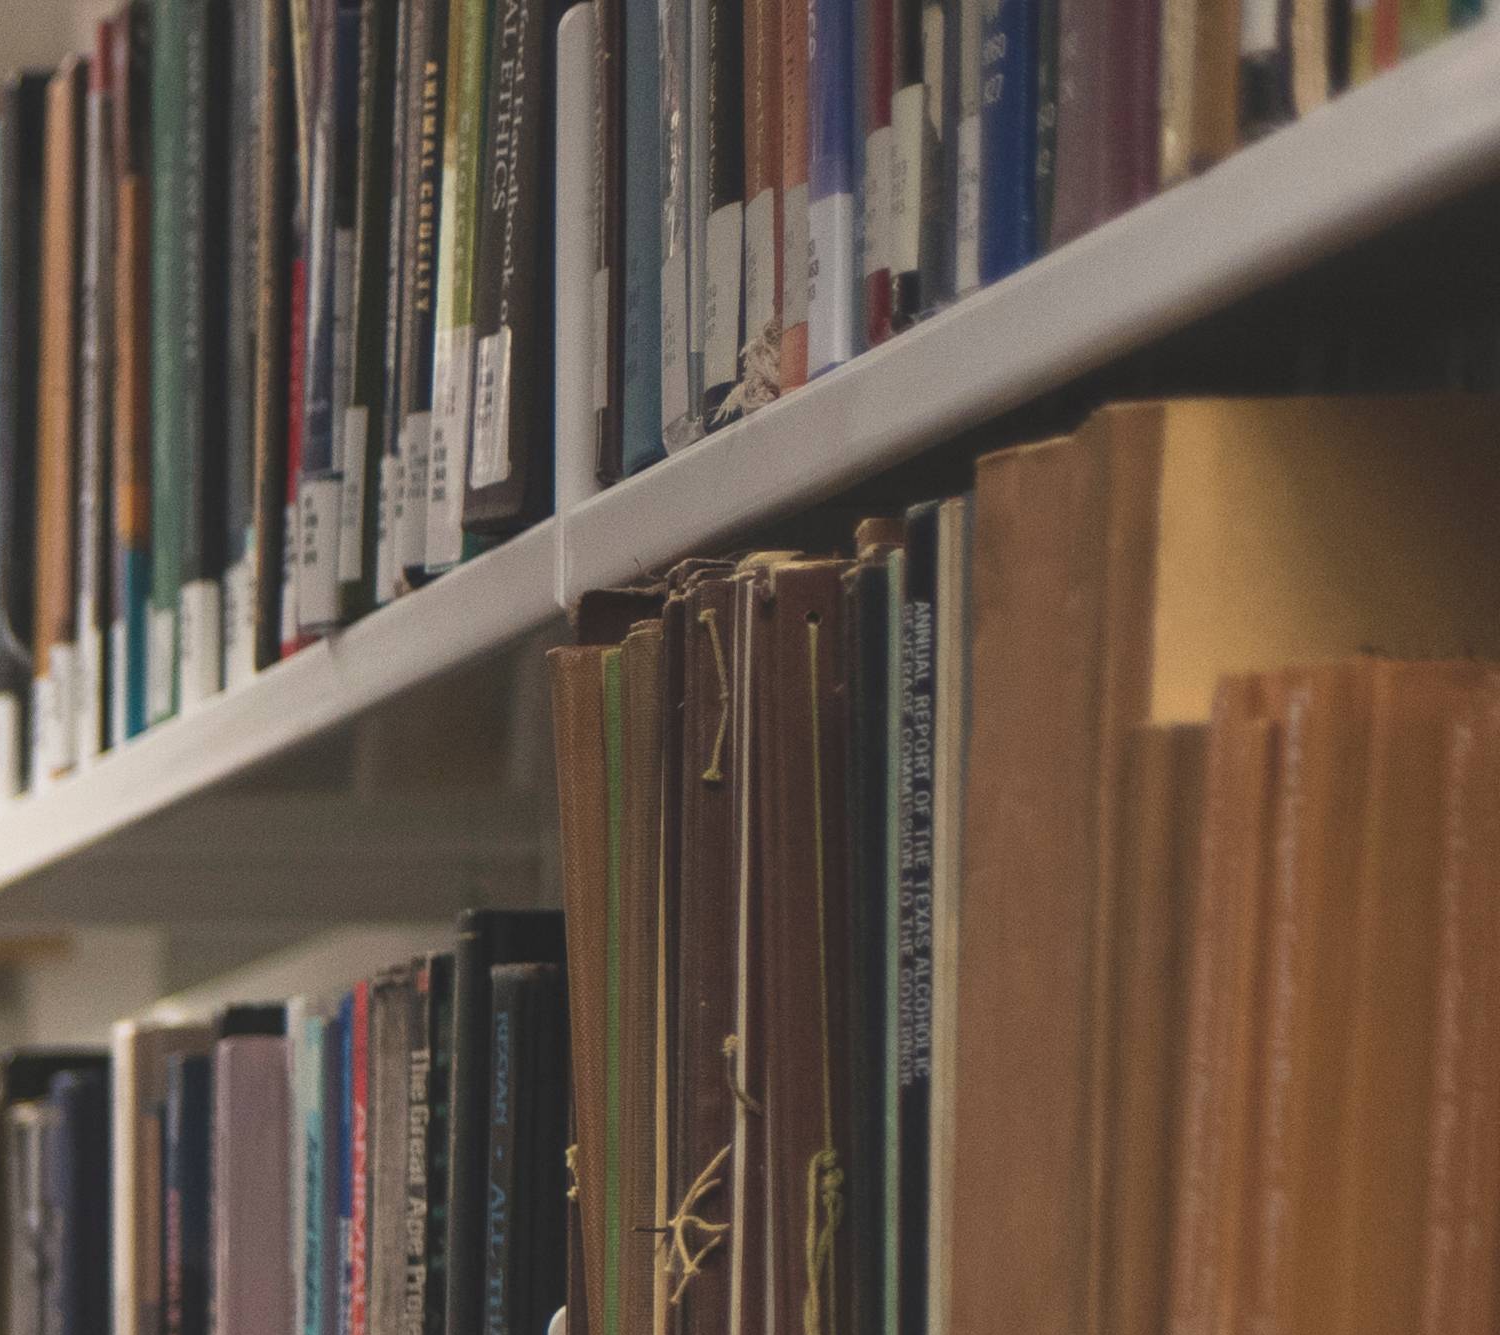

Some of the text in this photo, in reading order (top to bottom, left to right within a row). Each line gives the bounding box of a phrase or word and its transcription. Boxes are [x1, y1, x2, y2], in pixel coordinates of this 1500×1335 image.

[492, 0, 519, 212] AL ETHICS
[416, 62, 438, 313] ANIMAL CRUELTY
[502, 94, 525, 287] Handbook
[500, 300, 509, 322] o
[901, 731, 914, 870] COMMISSION
[914, 601, 931, 1079] ANNUAL REPORT OF THE TEXAS ALCOHOLIC
[410, 1048, 431, 1100] The
[901, 965, 914, 1088] GOVERNOR
[409, 1104, 430, 1185] Great
[406, 1196, 427, 1256] Ape
[491, 1181, 507, 1244] ALL
